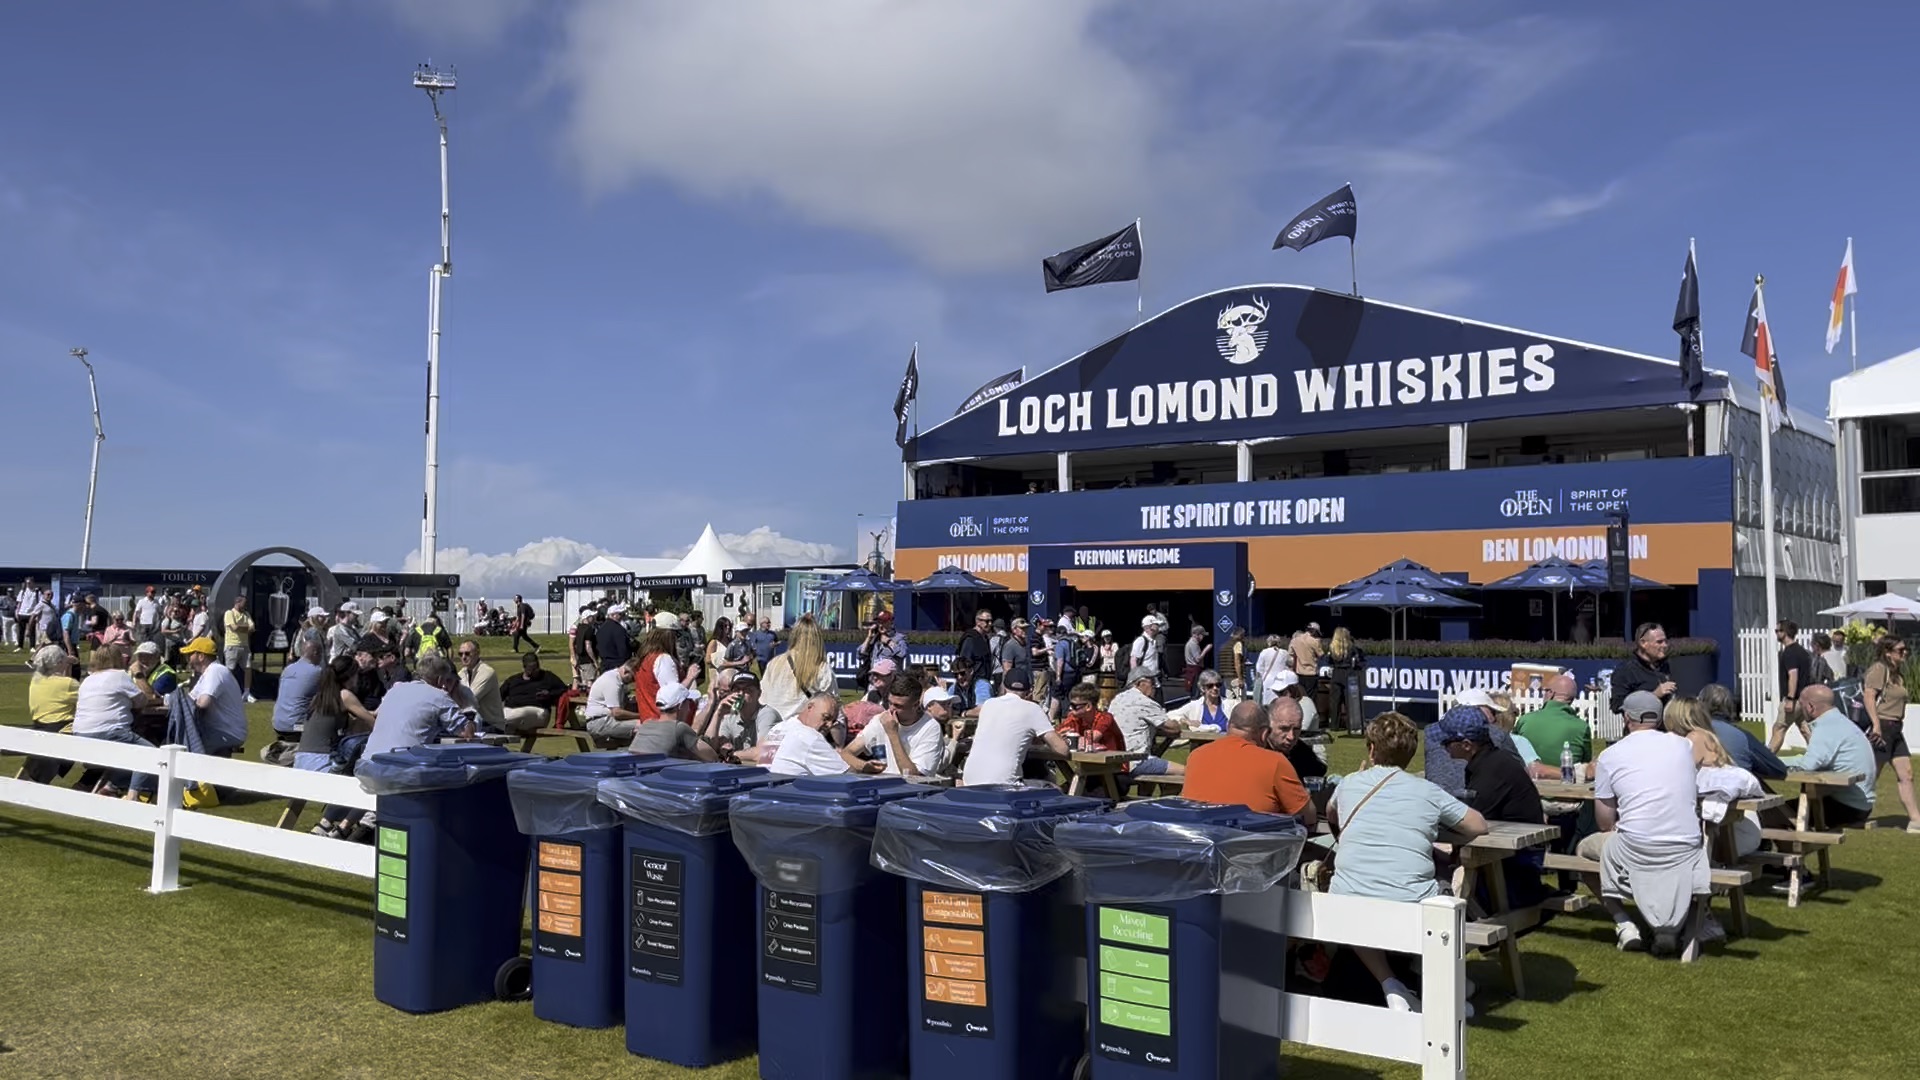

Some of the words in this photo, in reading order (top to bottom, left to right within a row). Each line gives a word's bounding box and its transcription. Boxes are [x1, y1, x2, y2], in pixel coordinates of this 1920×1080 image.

[998, 390, 1093, 436] LOCH
[1106, 373, 1278, 428] LOMOND
[1293, 343, 1555, 413] WHISKIES
[1515, 489, 1538, 501] THE
[1570, 489, 1609, 500] SPIRIT
[1611, 488, 1628, 498] OF
[1500, 498, 1553, 517] OPEN
[1570, 501, 1593, 512] THE
[1140, 505, 1171, 530] THE
[1173, 502, 1231, 529] SPIRIT
[1233, 501, 1255, 527] OF
[1258, 499, 1291, 525] THE
[1295, 497, 1345, 524] OPEN
[959, 516, 974, 525] THE
[993, 516, 1017, 525] SPIRIT
[1018, 516, 1029, 524] OF
[949, 522, 982, 538] OPEN
[993, 526, 1007, 534] THE
[1008, 526, 1029, 534] OPEN
[1482, 538, 1519, 562] BEN
[1523, 535, 1606, 562] LOMOND
[1628, 534, 1648, 559] IN
[938, 554, 961, 570] BEN
[963, 553, 1015, 572] LOMOND
[1074, 549, 1125, 566] EVERYONE
[1126, 547, 1181, 565] WELCOME
[161, 572, 207, 582] TOILETS
[355, 575, 393, 584] TOILETS
[567, 576, 604, 584] MULTI-FAITH
[605, 575, 624, 583] ROOM
[642, 578, 681, 586] ACCESSIBILITY
[1365, 667, 1445, 690] OMOND
[643, 859, 667, 870] General
[933, 895, 953, 906] Food
[954, 896, 970, 907] and
[927, 905, 980, 920] Compostables
[1119, 913, 1147, 928] Mixed
[1112, 924, 1154, 943] Recycling
